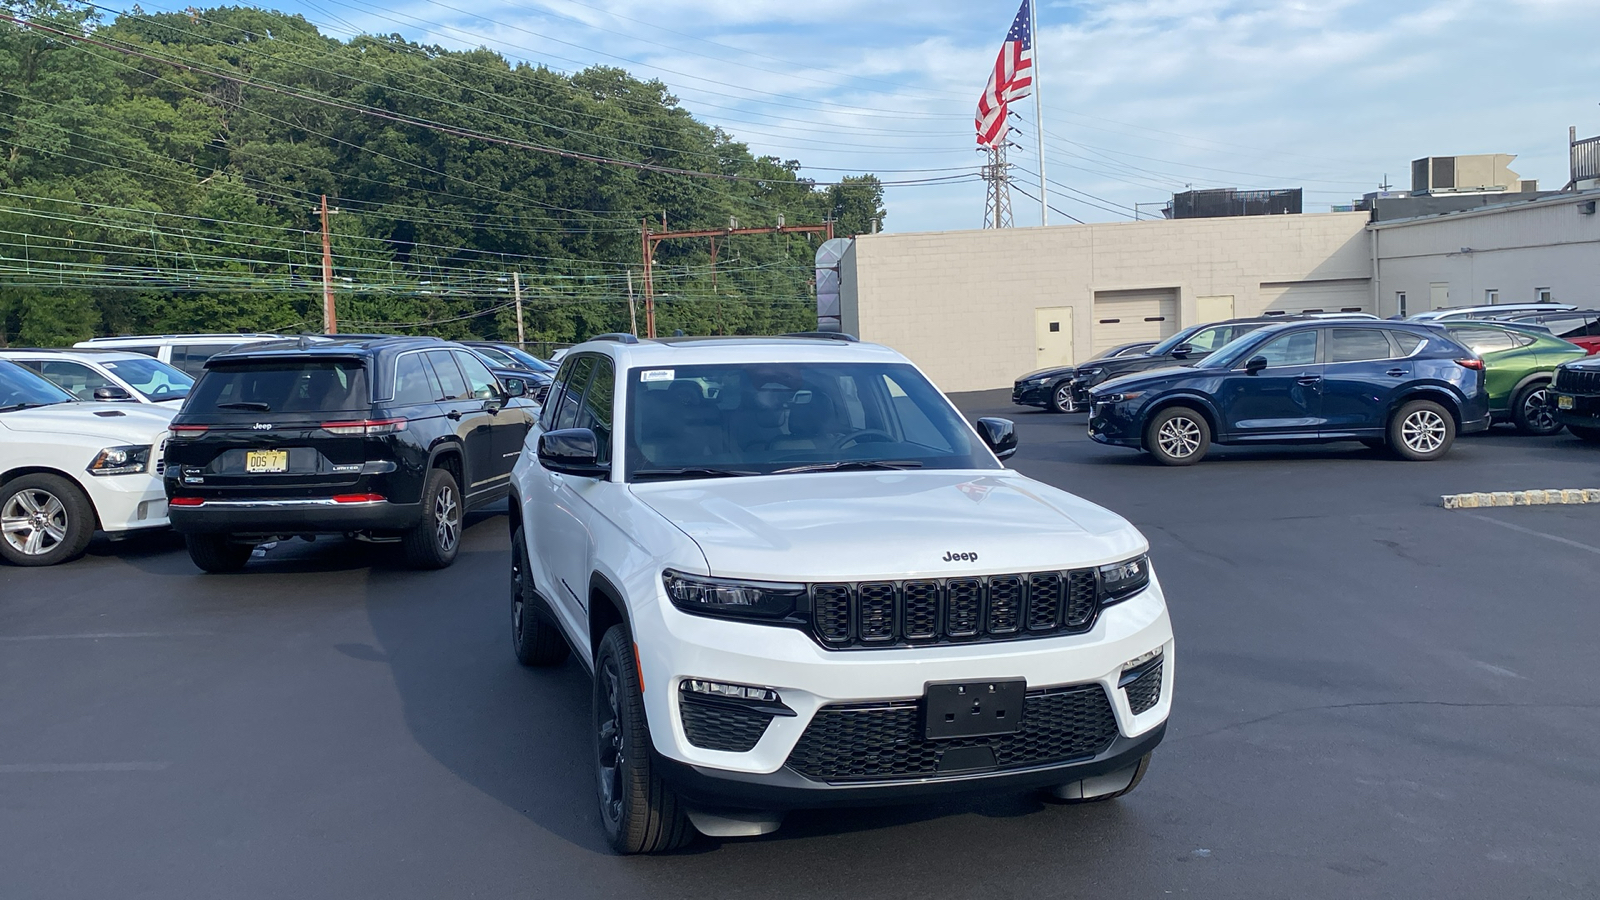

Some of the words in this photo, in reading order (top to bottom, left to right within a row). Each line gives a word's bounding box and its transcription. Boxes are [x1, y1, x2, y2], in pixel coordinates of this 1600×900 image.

[252, 422, 272, 431] Jeep
[272, 456, 278, 467] 7
[942, 551, 978, 563] Jeep
